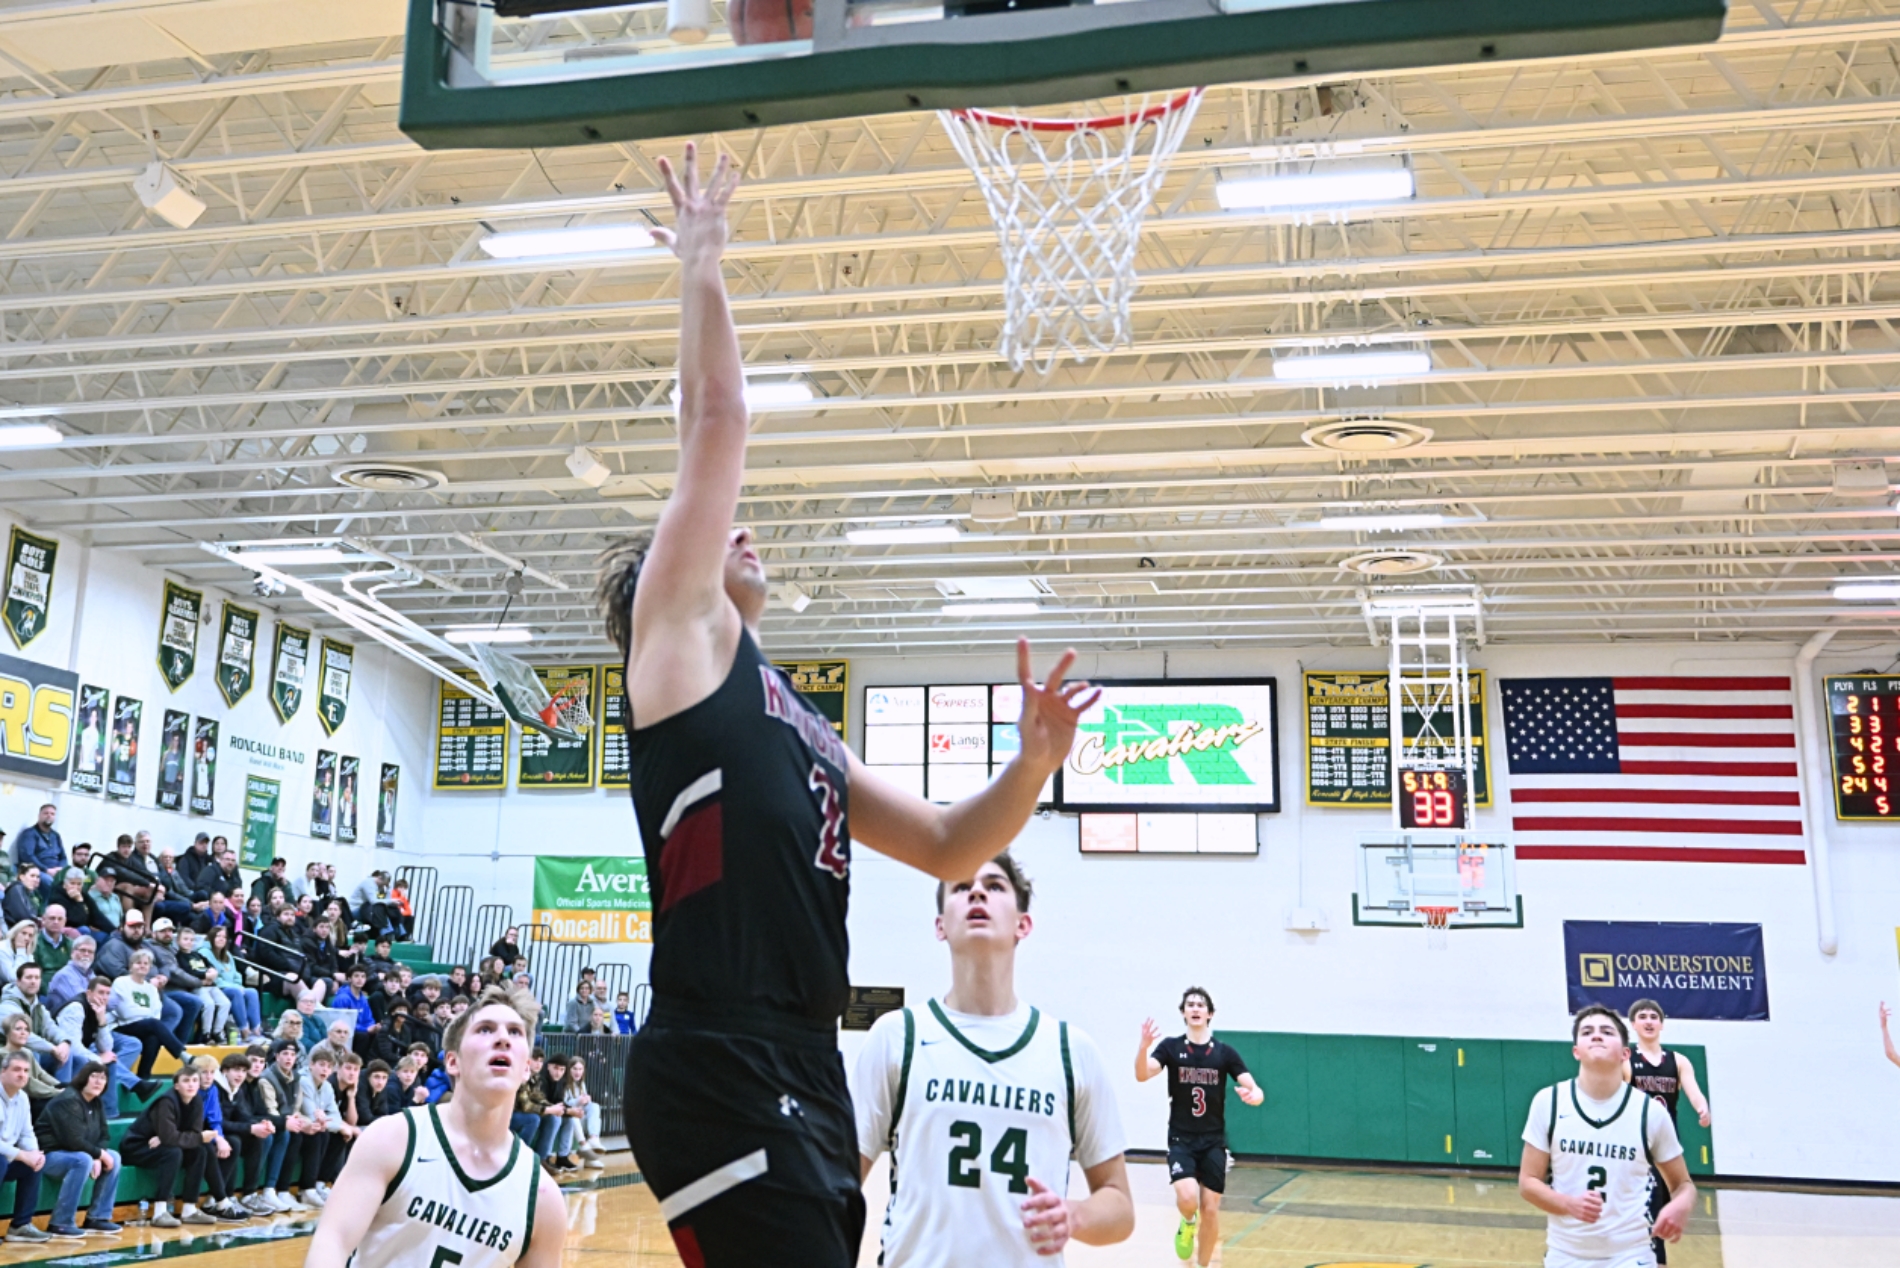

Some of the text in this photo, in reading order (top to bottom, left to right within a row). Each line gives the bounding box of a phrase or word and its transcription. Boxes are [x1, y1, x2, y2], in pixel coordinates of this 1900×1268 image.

[791, 666, 844, 684] OLF
[1308, 677, 1387, 696] TRACK
[1834, 681, 1854, 691] PLYR
[1863, 681, 1877, 691] FLS
[1847, 695, 1879, 714] 2 1
[1850, 715, 1881, 734] 3 3
[229, 735, 305, 765] RONCALLI BAND
[1069, 721, 1264, 775] Cavaliers
[1850, 737, 1863, 752] 4
[1870, 736, 1882, 753] 2
[1852, 755, 1885, 774] 5 2
[1842, 775, 1887, 794] 24 4
[1414, 791, 1453, 825] 33
[1876, 795, 1890, 815] 5
[575, 863, 651, 893] Avera
[556, 897, 651, 909] Official Sports Medicine
[540, 911, 619, 939] Roncalli
[1616, 954, 1754, 973] CORNERSTONE
[1618, 973, 1754, 990] MANAGEMENT
[925, 1078, 1055, 1116] CAVALIERS
[1191, 1086, 1206, 1117] 3
[948, 1119, 1029, 1195] 24
[1559, 1138, 1637, 1161] CAVALIERS
[1587, 1165, 1607, 1203] 2
[407, 1196, 513, 1252] CAVALIERS
